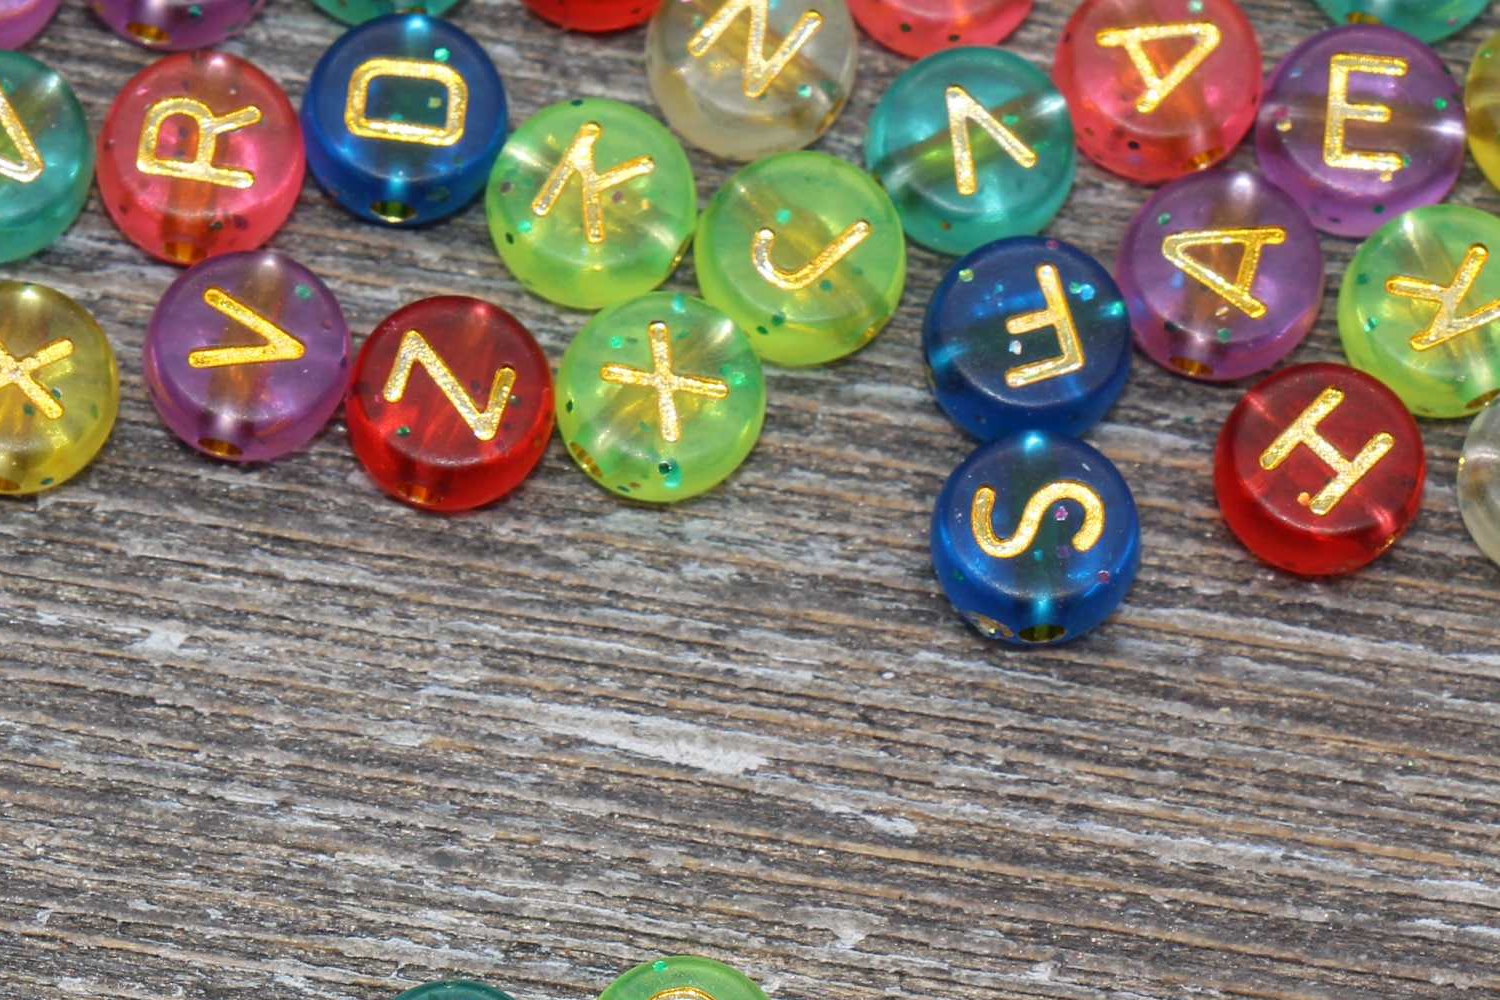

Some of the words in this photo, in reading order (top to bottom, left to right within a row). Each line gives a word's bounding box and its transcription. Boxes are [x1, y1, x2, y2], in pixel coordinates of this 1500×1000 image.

[1096, 21, 1221, 113] A
[1323, 52, 1408, 171] E
[137, 97, 262, 189] R
[532, 121, 655, 243] K
[945, 84, 1038, 196] V
[752, 219, 871, 290] J
[1161, 225, 1286, 319] A
[188, 285, 305, 367] V
[1005, 263, 1085, 388] F
[601, 321, 729, 442] X
[1259, 385, 1395, 516] H
[971, 478, 1105, 558] S
